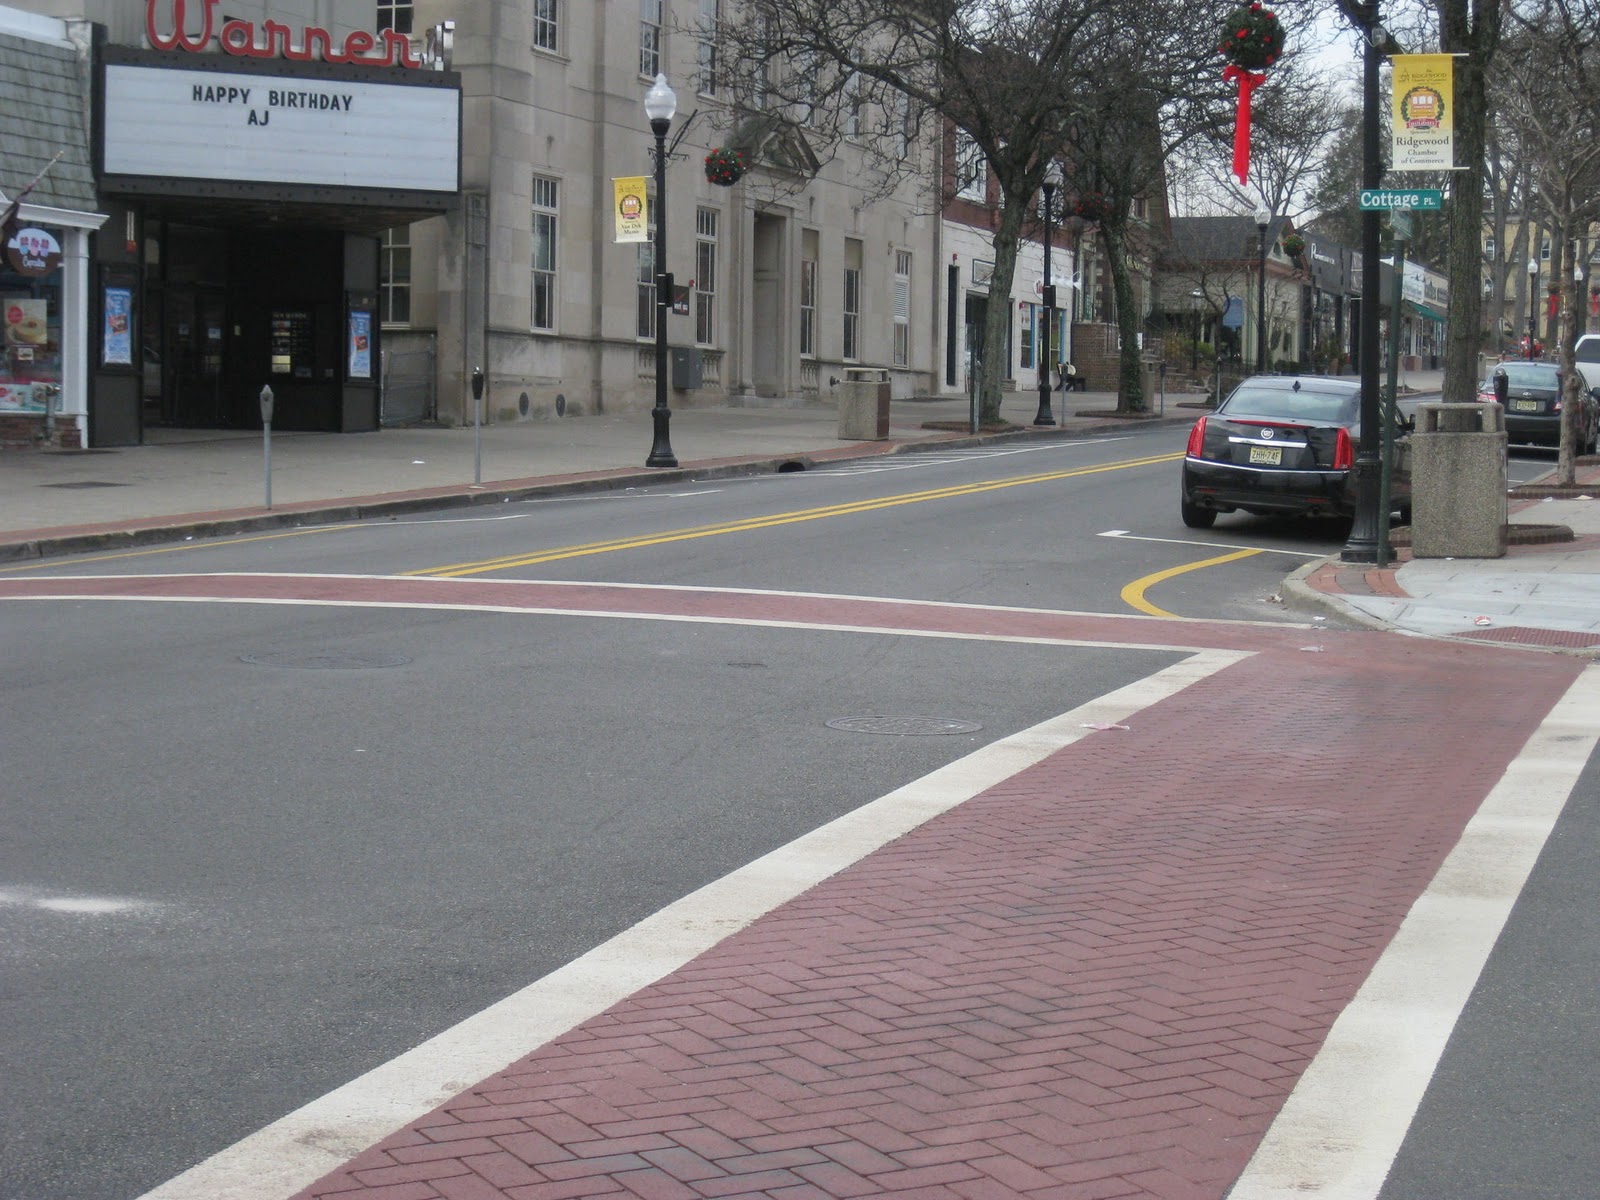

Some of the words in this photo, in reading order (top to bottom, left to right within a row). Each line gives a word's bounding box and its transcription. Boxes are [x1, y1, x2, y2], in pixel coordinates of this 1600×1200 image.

[147, 0, 421, 68] Warner
[192, 85, 251, 104] HAPPY
[268, 90, 353, 111] BIRTHDAY
[247, 109, 270, 126] AJ
[1396, 136, 1449, 148] Ridgewood
[1361, 192, 1419, 207] Cottage
[1423, 197, 1436, 206] PL.
